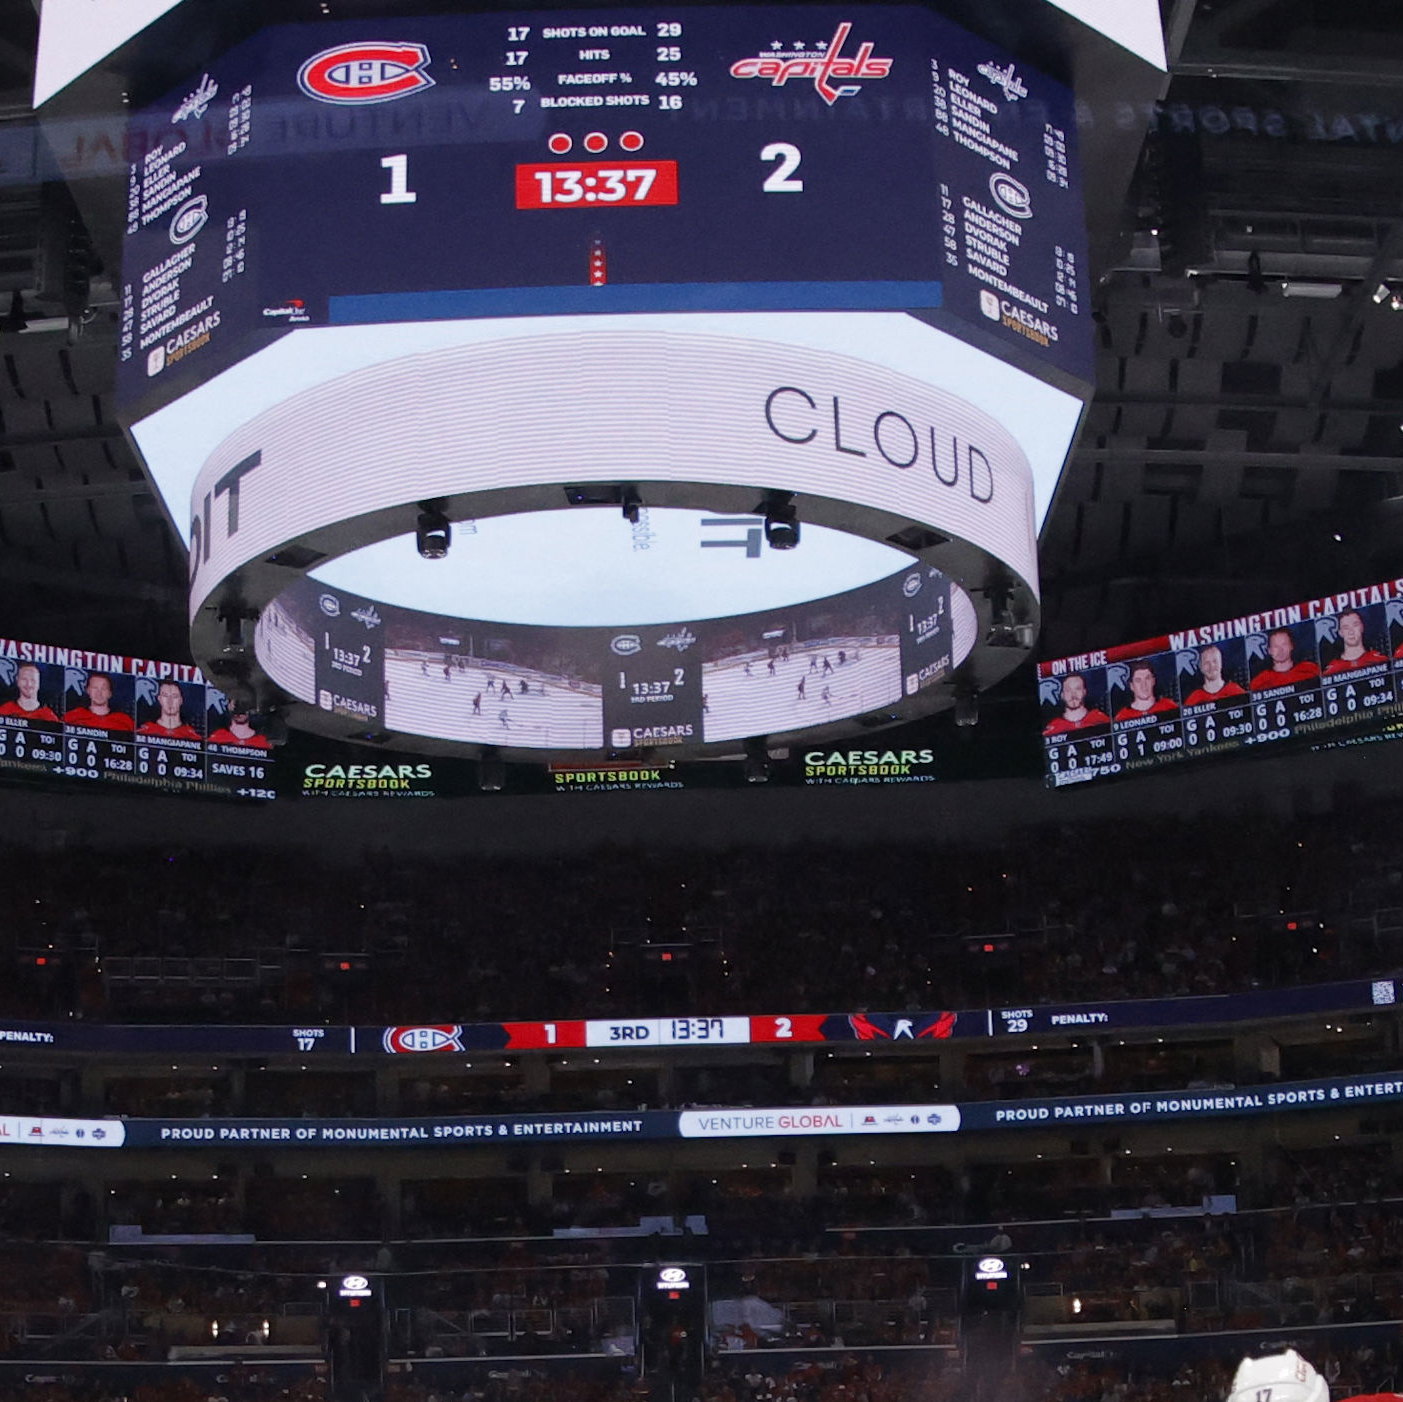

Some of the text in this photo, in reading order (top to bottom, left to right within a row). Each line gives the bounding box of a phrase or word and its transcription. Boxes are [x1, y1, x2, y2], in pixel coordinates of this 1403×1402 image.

[508, 23, 682, 41] 17 SHOTS ON GOAL 29
[506, 48, 681, 66] 17 HITS 25
[490, 72, 698, 91] 55% FACEOFF % 45%
[513, 95, 682, 114] 7 BLOCKED SHOTS 16
[953, 131, 1010, 170] THOMPSON
[760, 142, 803, 192] 2
[380, 154, 416, 203] 1
[534, 169, 657, 203] 13:37
[962, 197, 1021, 235] GALLAGHER
[964, 209, 1019, 246] ANDERSON
[965, 222, 1007, 252] DVORAK
[965, 235, 1010, 266] STRUBLE
[966, 248, 1007, 276] SAVARD
[968, 264, 1048, 313] MONTEMBEAULT
[1001, 301, 1058, 341] CAESARS
[765, 386, 994, 504] CLOUD
[1169, 605, 1299, 651] WASHINGTON
[1052, 650, 1107, 675] ON THE ICE
[632, 682, 670, 695] 13:37
[634, 724, 694, 738] CAESARS
[305, 764, 433, 779] CAESARS
[1001, 1009, 1034, 1020] SHOTS
[1051, 1011, 1108, 1026] PENALTY:
[292, 1029, 324, 1038] SHOTS
[544, 1024, 557, 1044] 1
[609, 1019, 724, 1041] 3RD 13:37
[775, 1019, 793, 1037] 2
[1007, 1018, 1028, 1033] 29
[298, 1037, 315, 1051] 17
[161, 1120, 643, 1140] PROUD PARTNER OF MONUMENTAL SPORTS & ENTERTAINMENT
